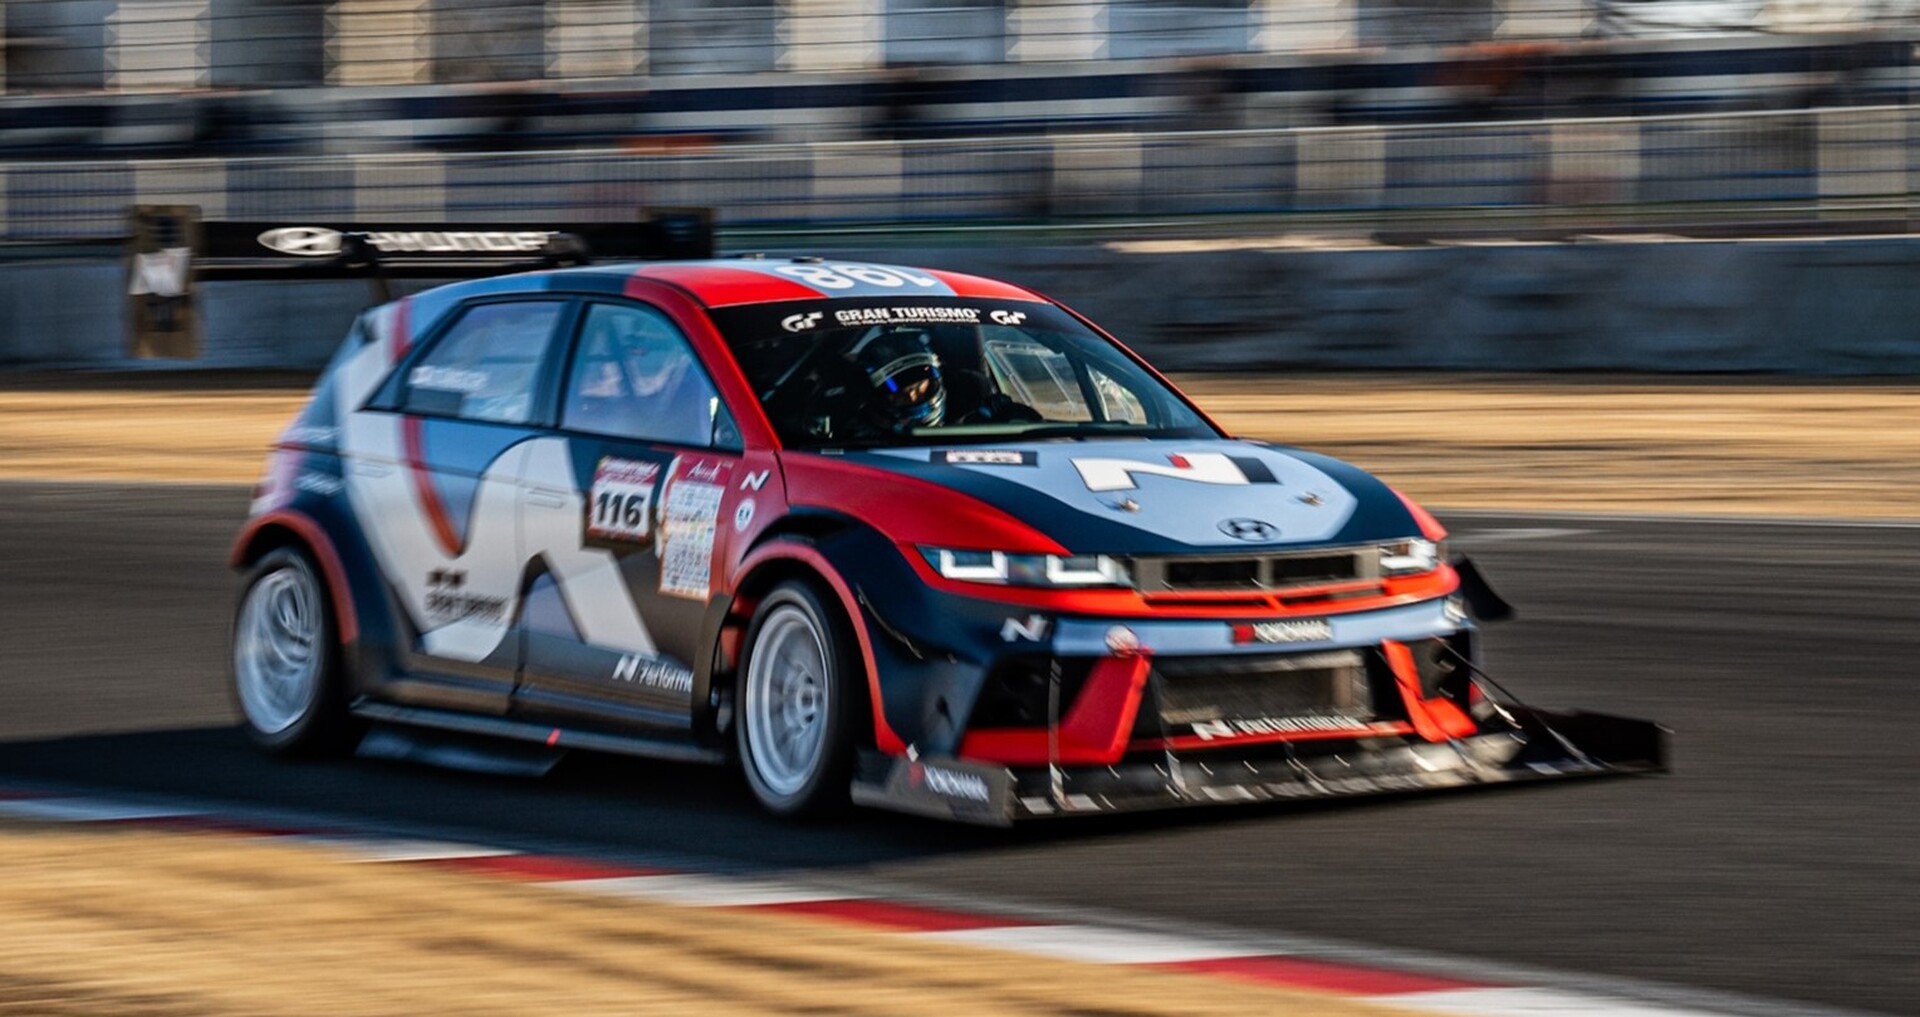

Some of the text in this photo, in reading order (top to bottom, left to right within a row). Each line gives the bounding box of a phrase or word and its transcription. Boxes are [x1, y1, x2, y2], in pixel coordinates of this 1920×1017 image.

[834, 307, 977, 322] GRAN TURISMO
[739, 469, 771, 492] N
[595, 491, 646, 529] 116
[612, 653, 641, 682] N
